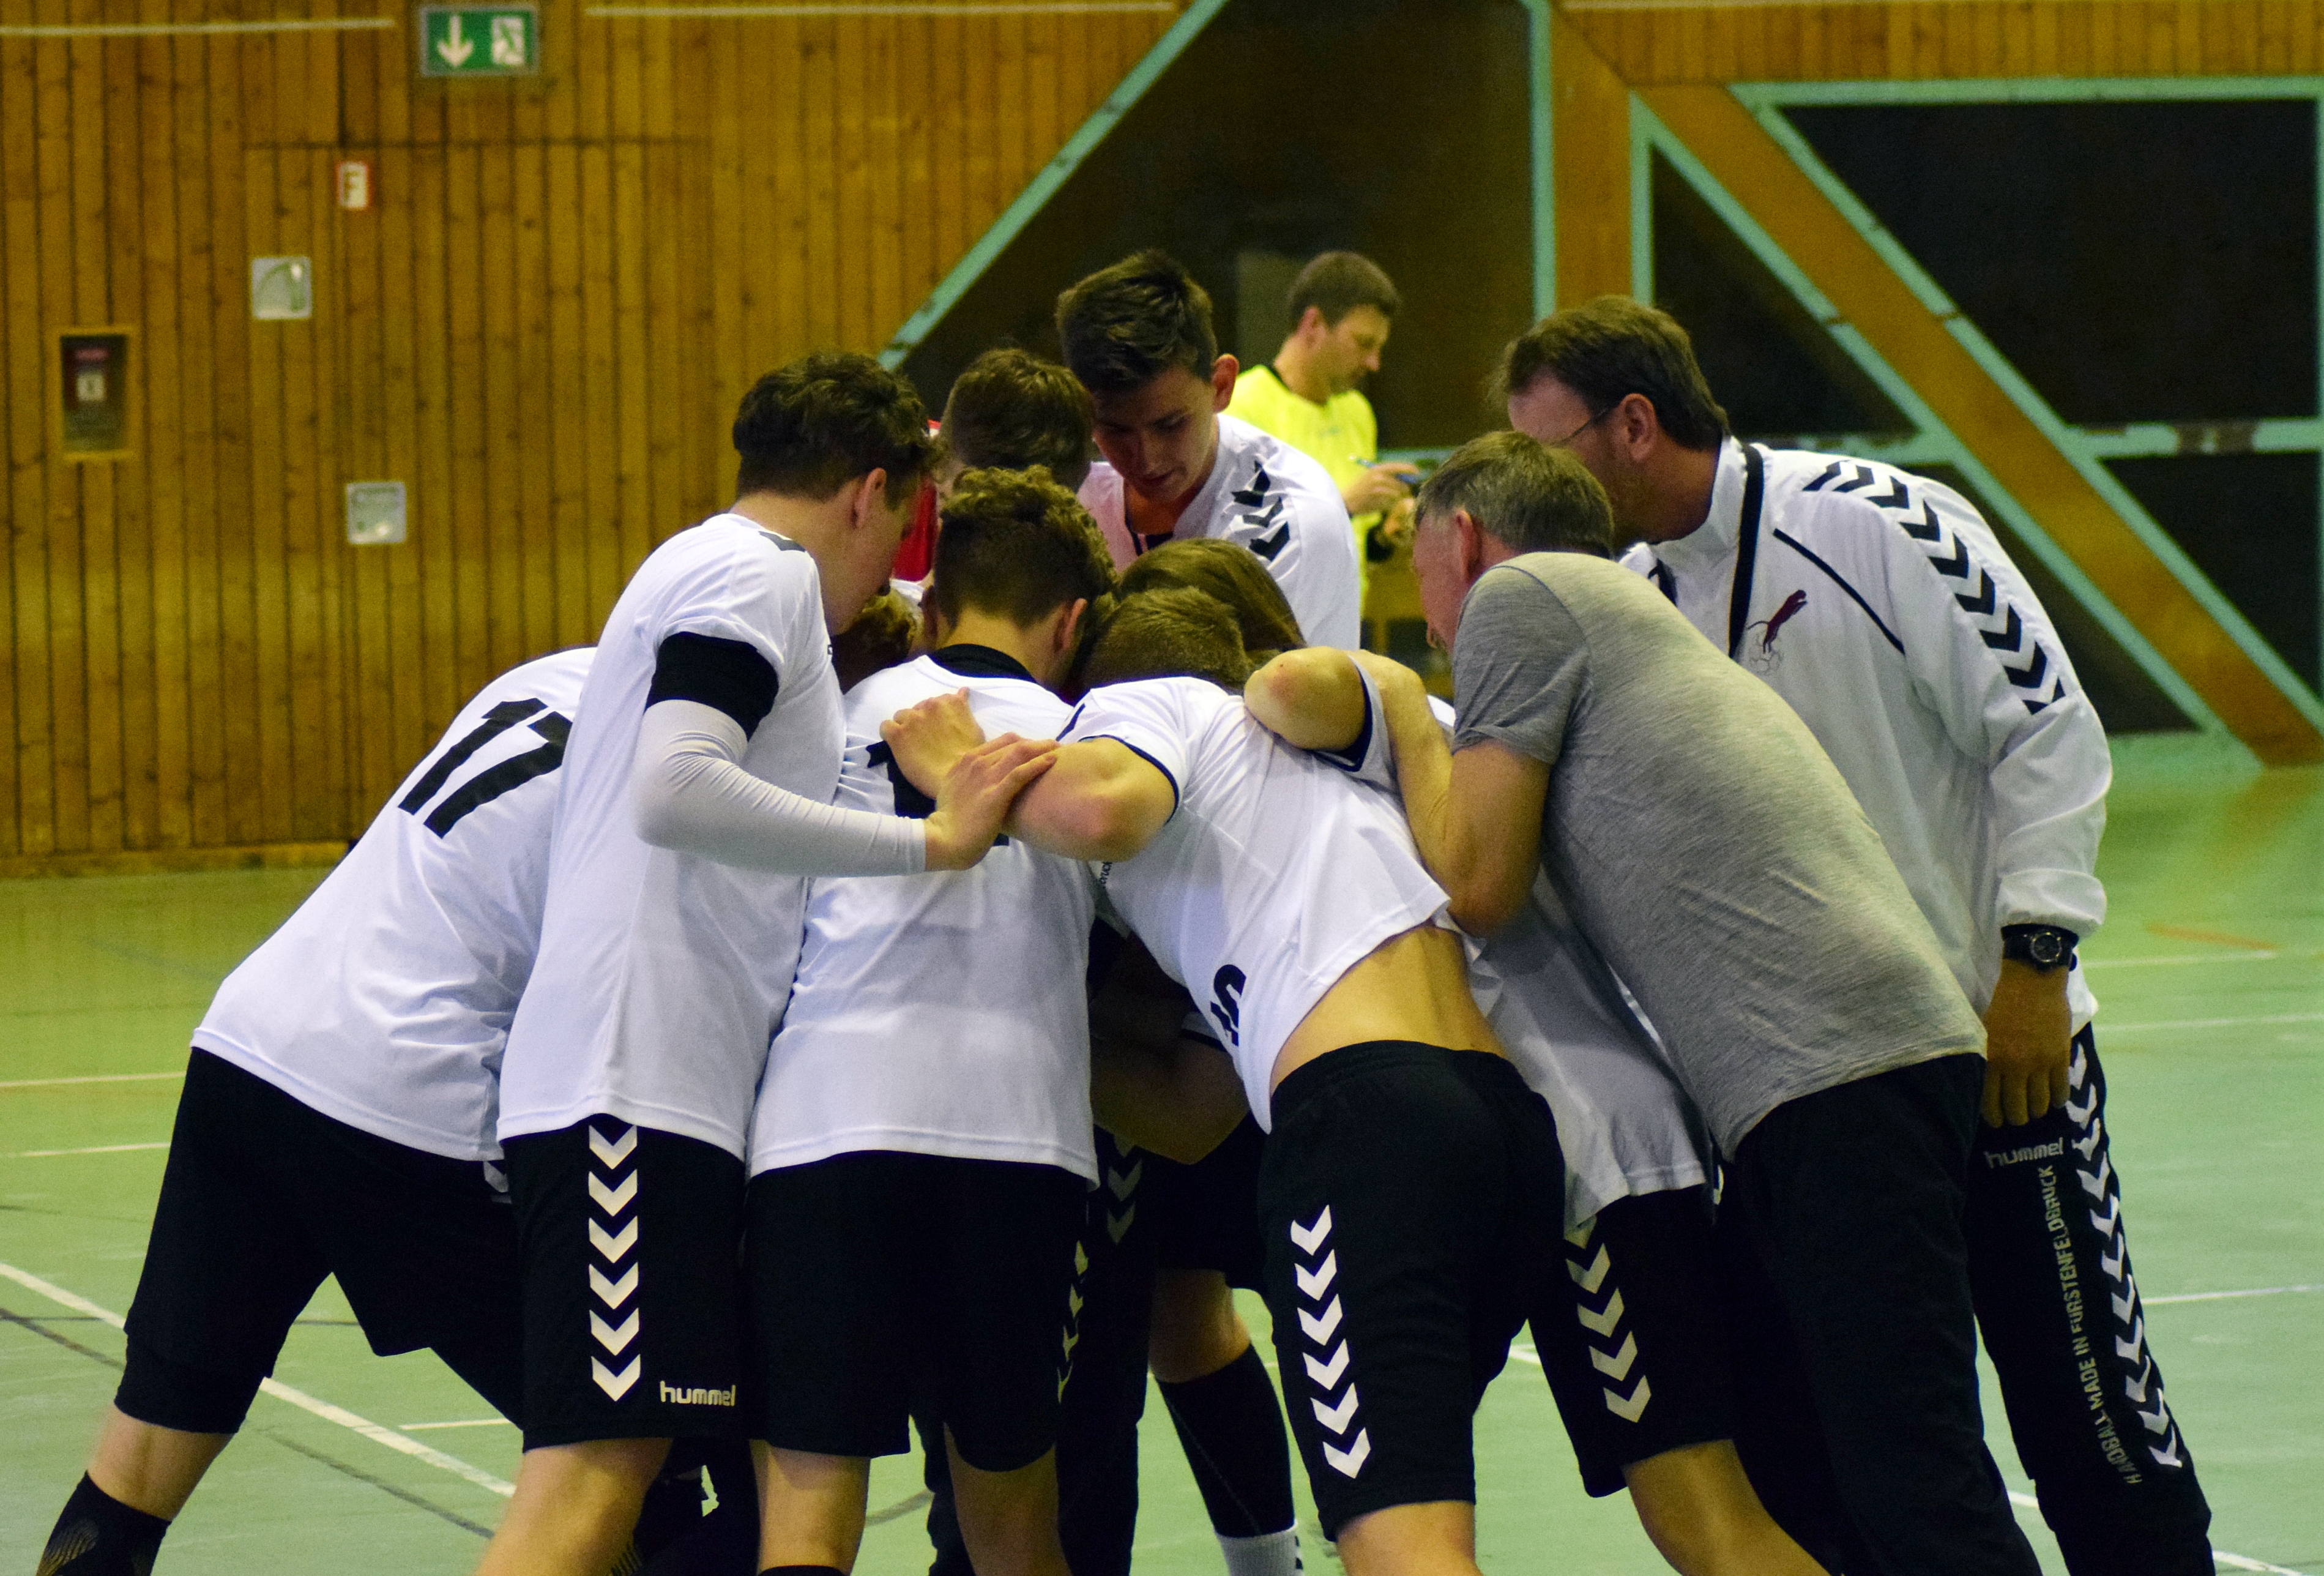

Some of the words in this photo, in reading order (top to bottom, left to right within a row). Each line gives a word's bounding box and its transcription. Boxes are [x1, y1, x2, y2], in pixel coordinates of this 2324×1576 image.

[1984, 1137, 2063, 1168] hummel
[2072, 1336, 2090, 1356] IN
[660, 1380, 736, 1406] hummel
[2079, 1357, 2104, 1410] MADE
